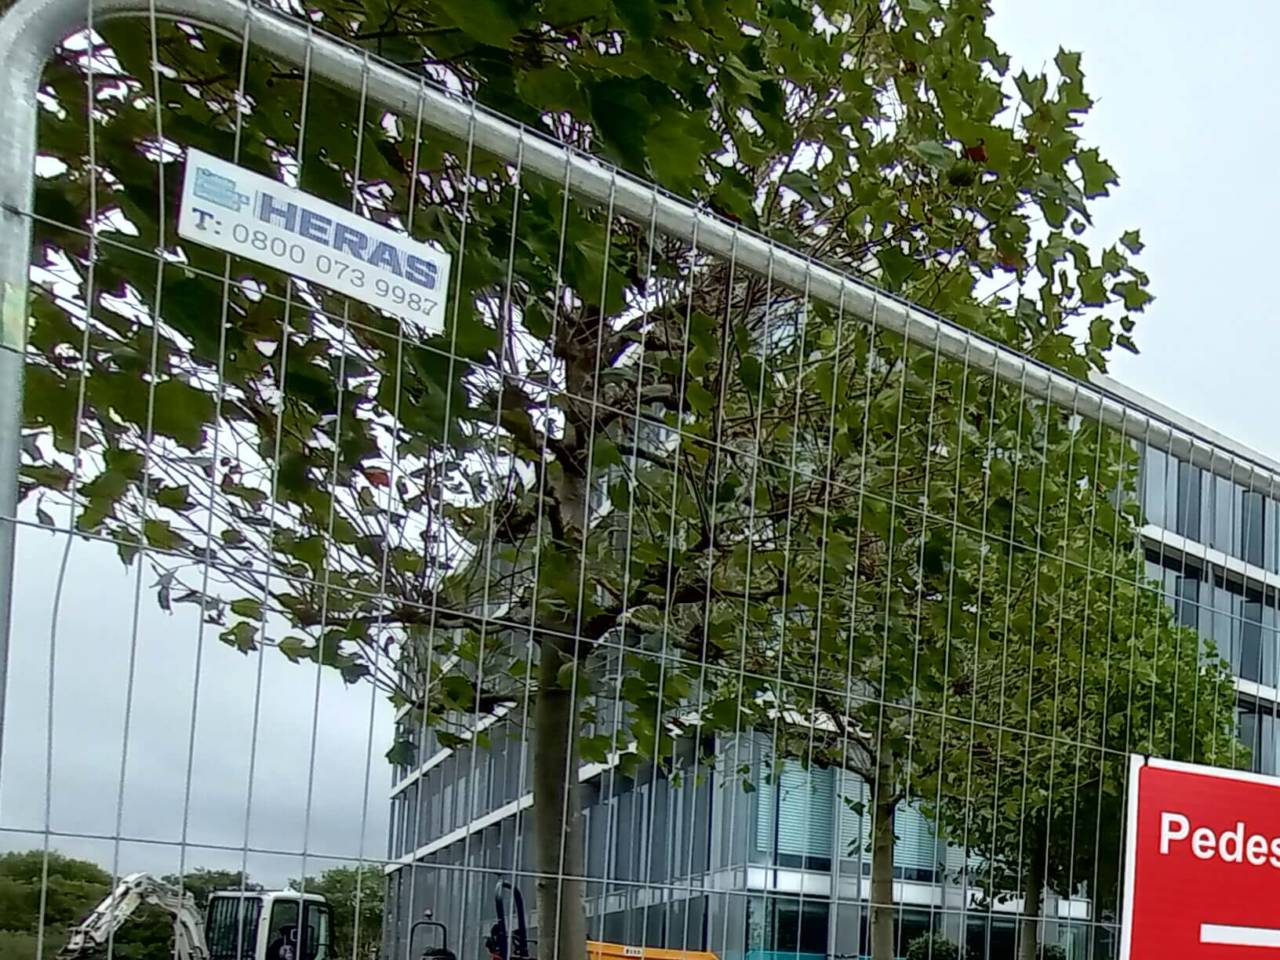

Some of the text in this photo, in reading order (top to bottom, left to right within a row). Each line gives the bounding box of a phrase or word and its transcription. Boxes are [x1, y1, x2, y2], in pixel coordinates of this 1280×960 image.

[192, 207, 439, 316] T: 0800 073 9987
[259, 192, 438, 291] HERAS
